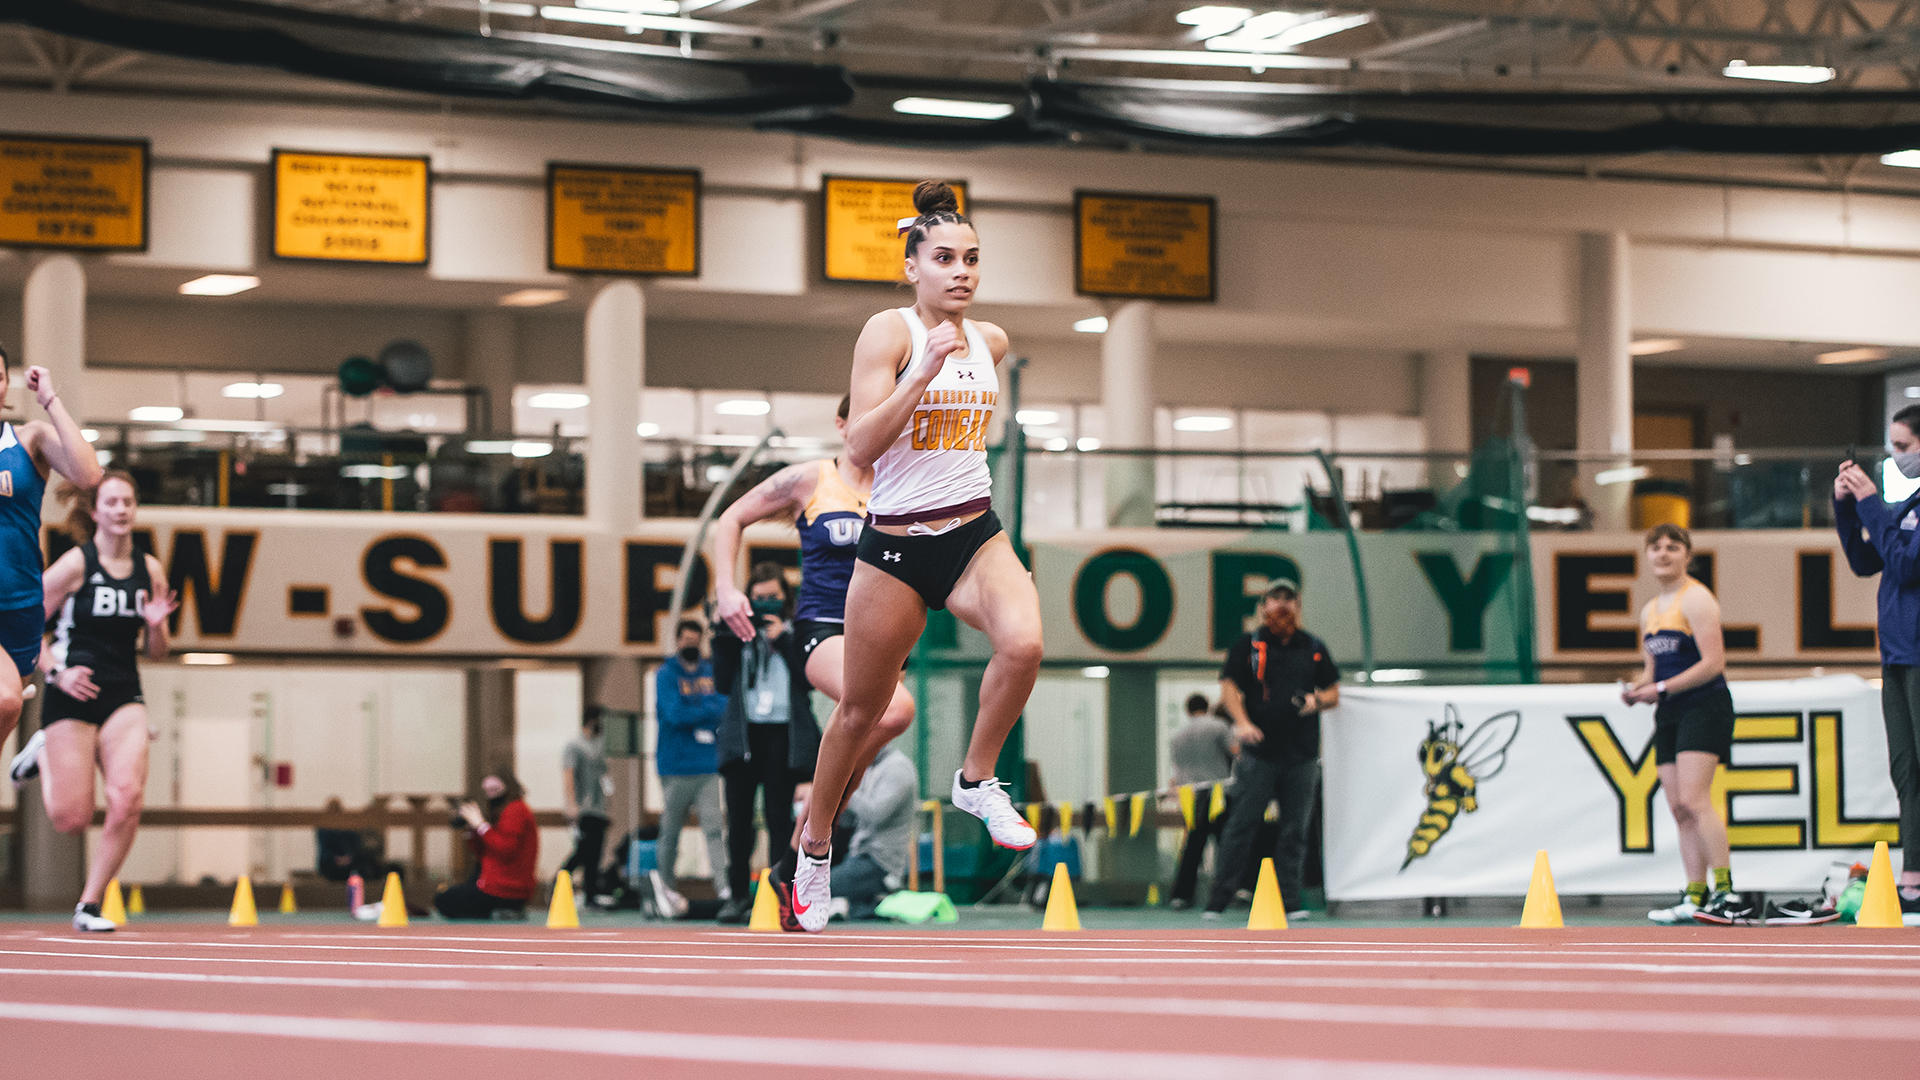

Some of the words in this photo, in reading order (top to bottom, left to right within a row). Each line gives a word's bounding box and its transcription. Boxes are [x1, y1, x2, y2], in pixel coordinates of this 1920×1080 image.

[918, 390, 977, 405] NNESOTA
[823, 517, 865, 546] U
[44, 526, 1303, 654] W-SUPOR
